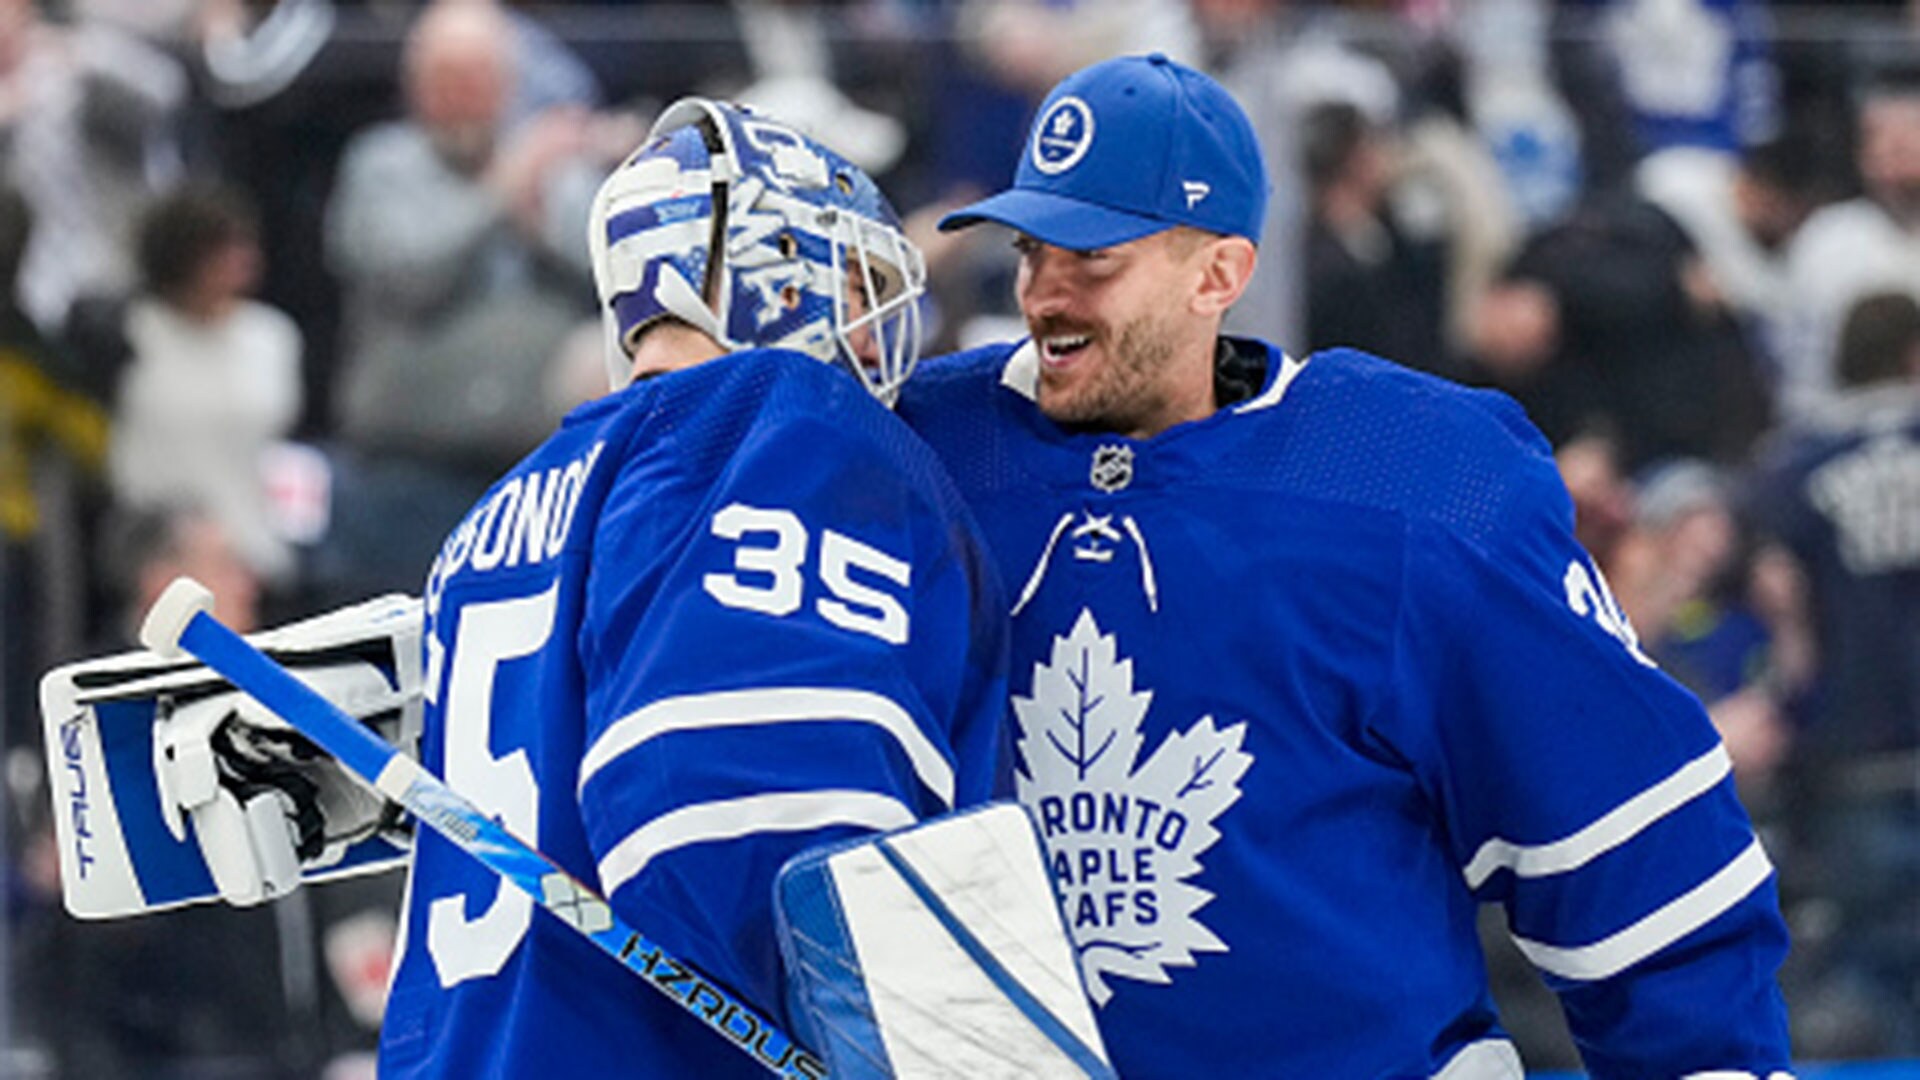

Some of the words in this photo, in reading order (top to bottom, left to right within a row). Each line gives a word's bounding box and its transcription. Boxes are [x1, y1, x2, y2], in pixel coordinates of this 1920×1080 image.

[704, 502, 912, 645] 35
[424, 577, 559, 990] 5
[1039, 791, 1187, 850] RONTO
[1054, 847, 1156, 885] APLE
[1062, 889, 1159, 928] AFS
